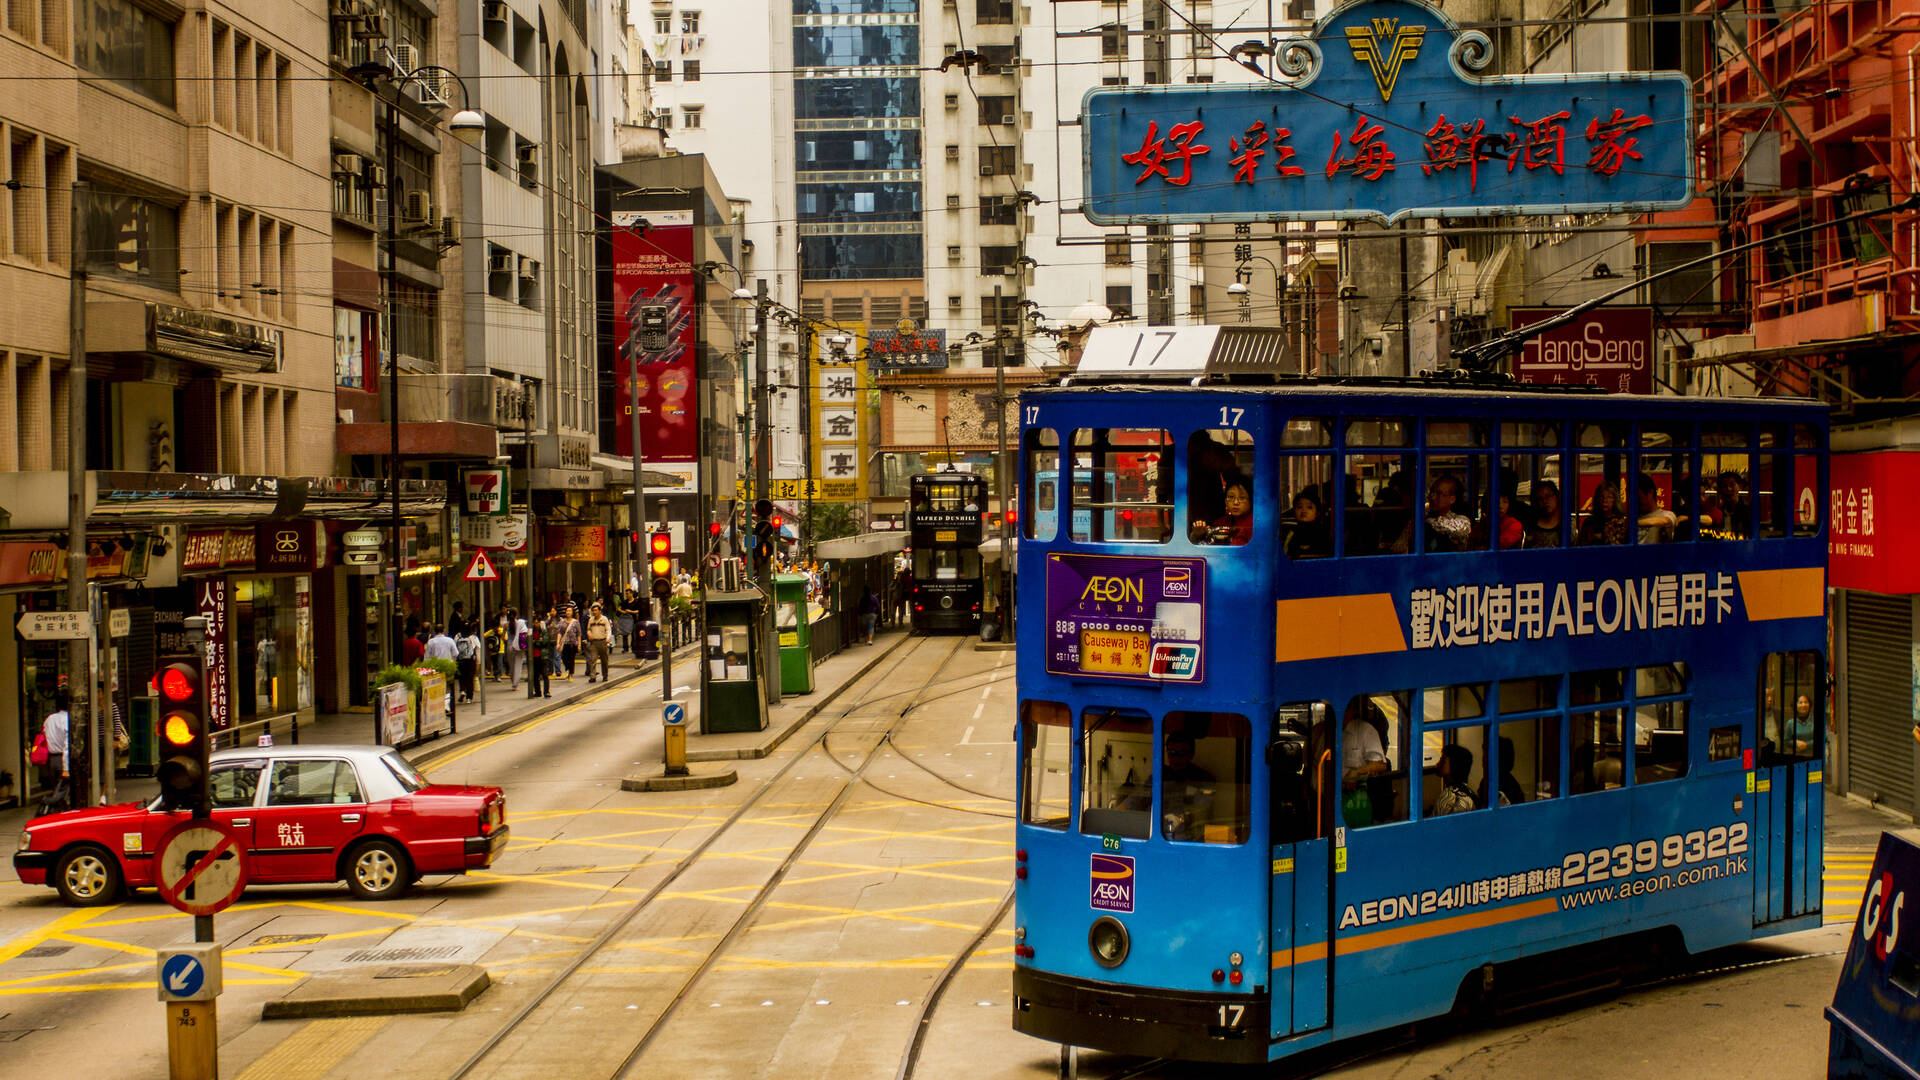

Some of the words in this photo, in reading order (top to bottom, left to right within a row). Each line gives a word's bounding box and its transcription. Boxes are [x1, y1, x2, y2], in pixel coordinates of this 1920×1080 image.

[1122, 109, 1652, 193] 好彩海鮮酒家
[1128, 331, 1177, 366] 17
[1026, 406, 1040, 424] 17
[1219, 406, 1245, 426] 17
[216, 581, 225, 632] MONEY
[1410, 571, 1734, 650] 歡迎使用AEON信用卡
[36, 614, 66, 622] Cleverly
[68, 613, 77, 621] St
[1083, 632, 1129, 652] Causeway
[1132, 636, 1150, 653] Bay
[218, 644, 226, 726] EXCHANGE
[278, 823, 304, 834] 的士
[278, 834, 304, 846] TAXI
[1103, 837, 1119, 850] C76
[1562, 856, 1749, 910] www.aeon.com.hk
[1093, 898, 1110, 907] CREDIT
[1110, 900, 1130, 909] SERVICE
[1863, 870, 1905, 962] G4S
[177, 1016, 196, 1026] 743
[1218, 1005, 1245, 1027] 17
